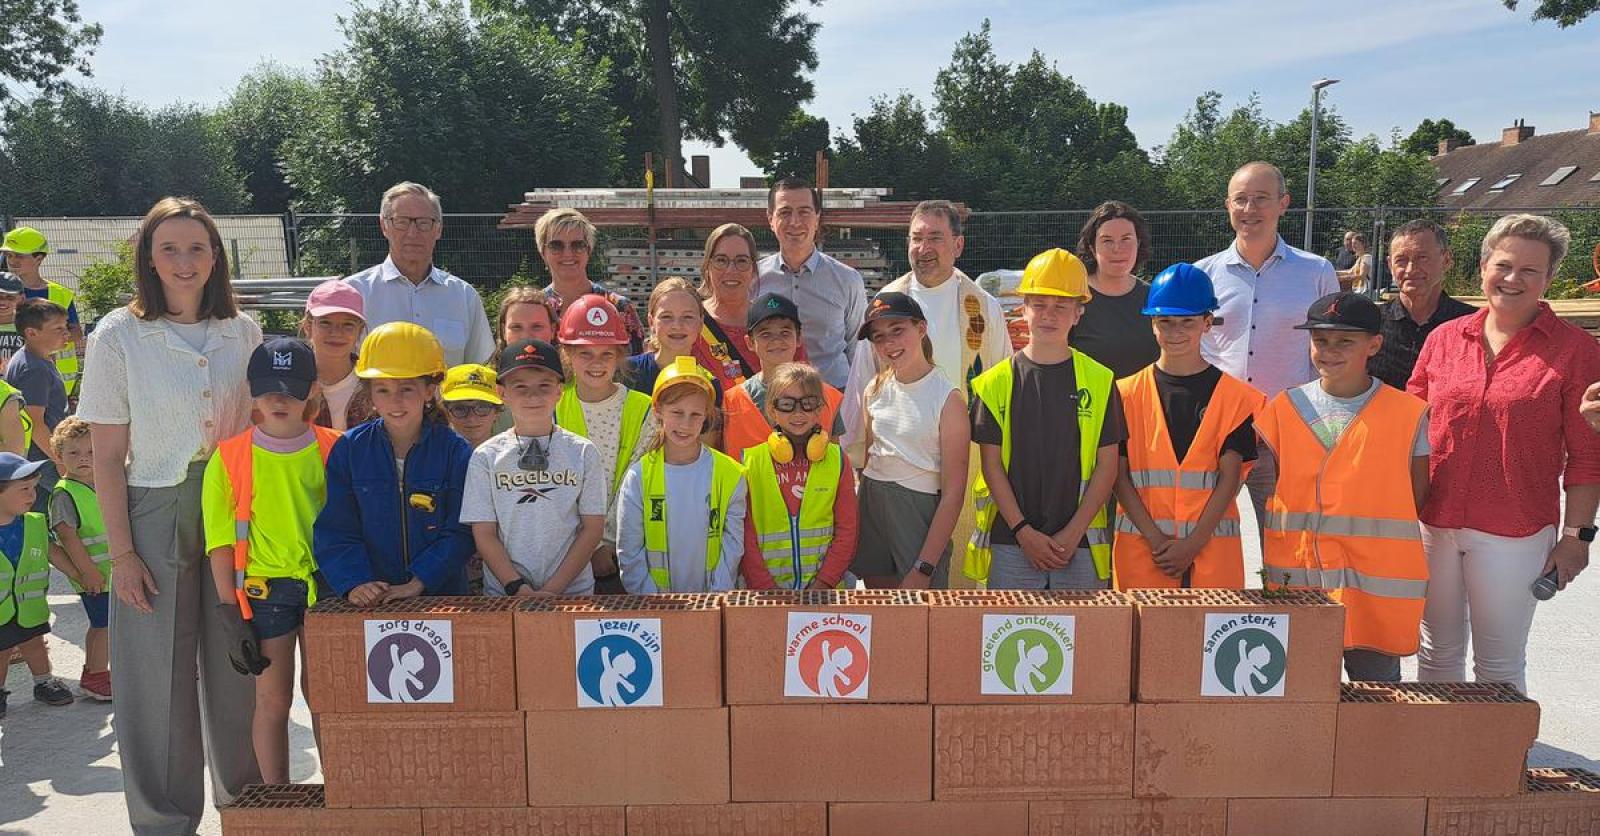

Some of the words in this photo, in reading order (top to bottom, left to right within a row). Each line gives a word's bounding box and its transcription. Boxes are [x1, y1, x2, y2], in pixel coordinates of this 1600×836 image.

[496, 469, 577, 491] Reebok
[378, 620, 409, 633] zorg
[414, 621, 452, 659] dragen
[598, 619, 640, 635] jezelf
[640, 631, 660, 653] zijn
[788, 621, 819, 657] warme
[822, 614, 867, 634] school
[983, 618, 1013, 672] groeiend
[1016, 616, 1073, 651] ontdekken
[1204, 619, 1238, 654] samen
[1241, 614, 1277, 628] sterk
